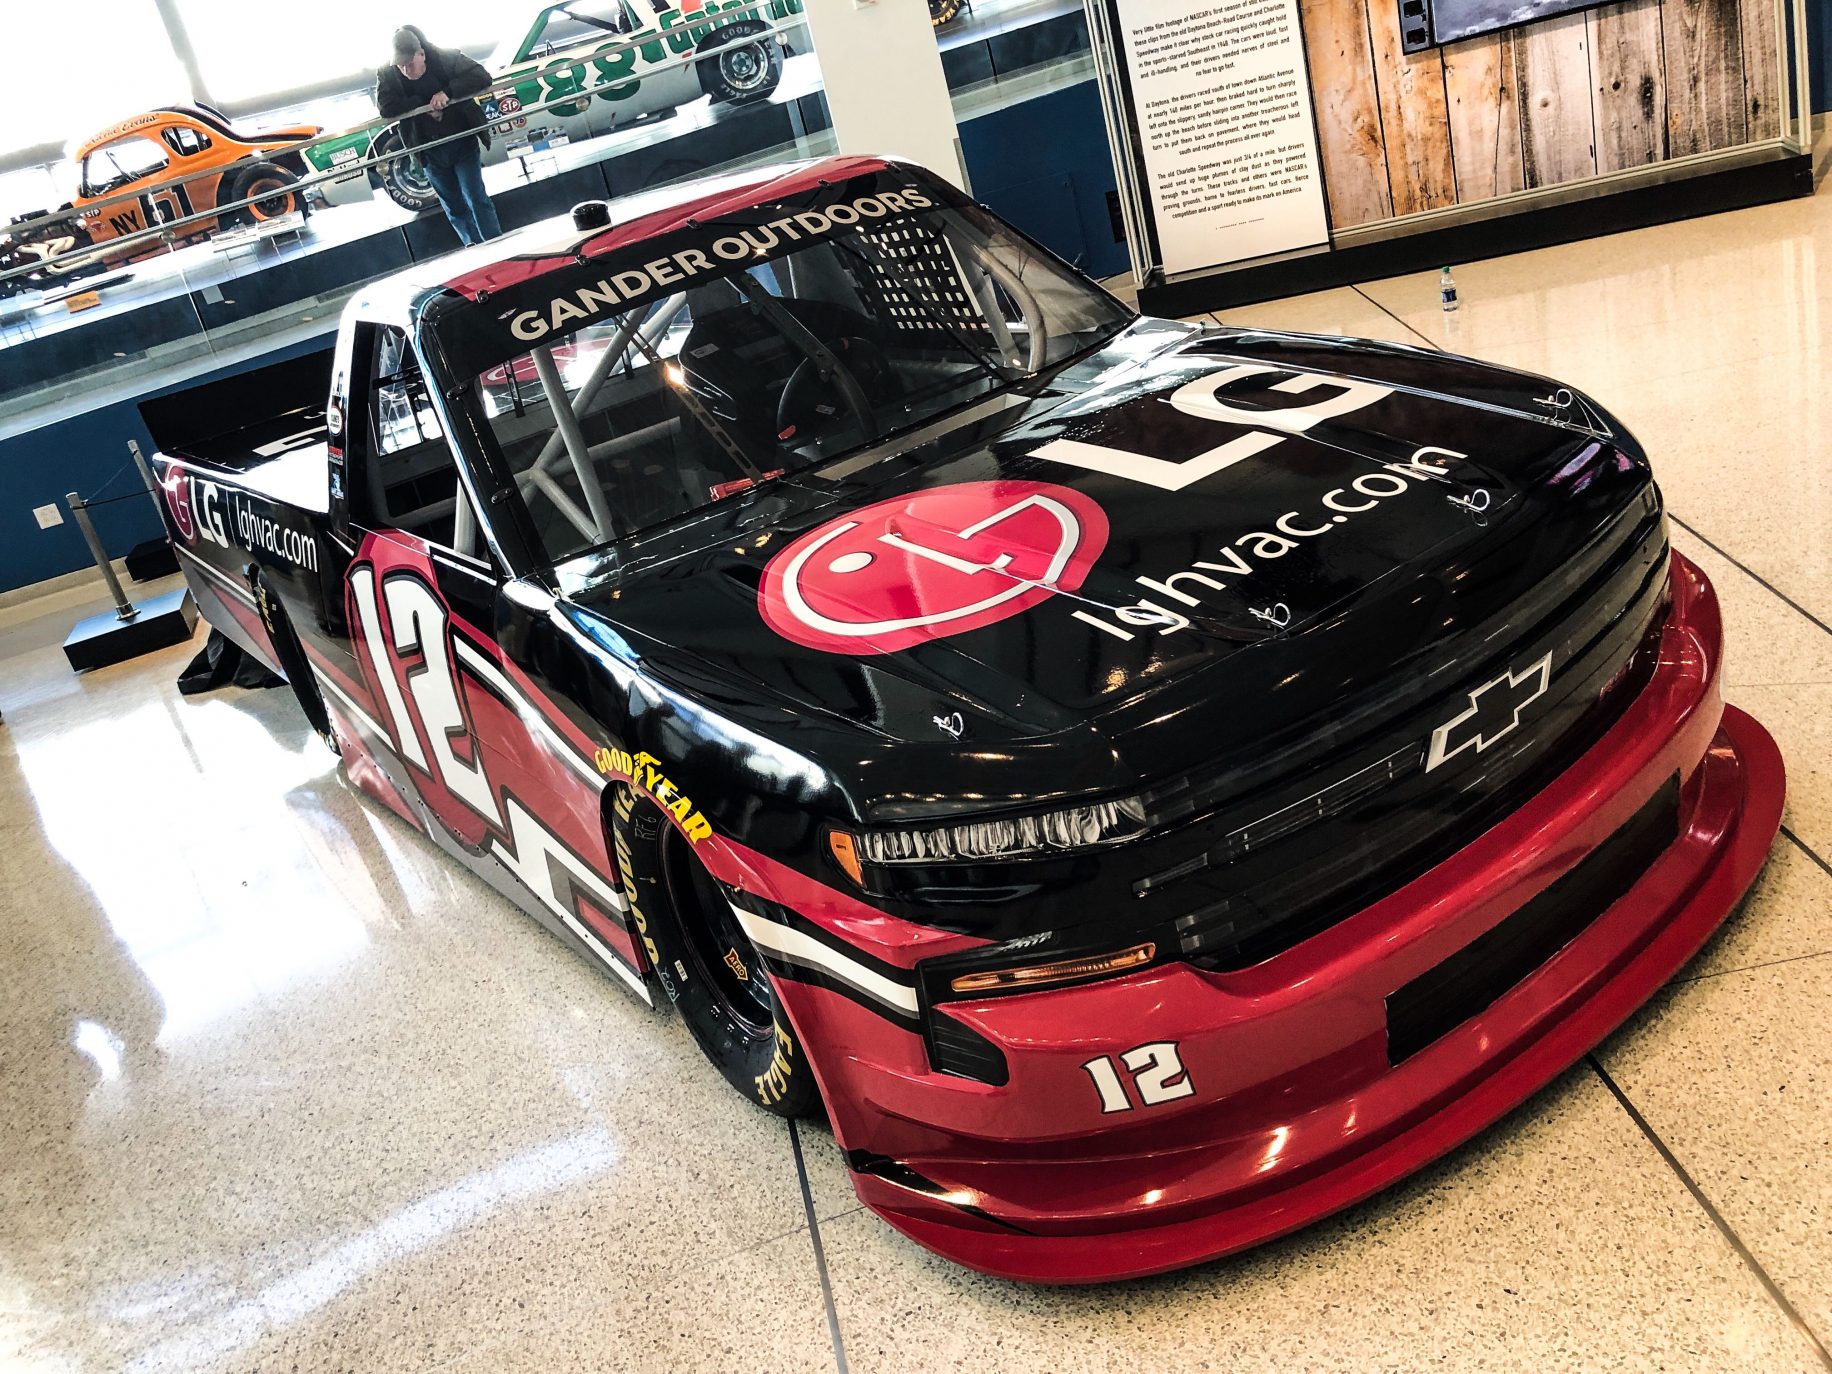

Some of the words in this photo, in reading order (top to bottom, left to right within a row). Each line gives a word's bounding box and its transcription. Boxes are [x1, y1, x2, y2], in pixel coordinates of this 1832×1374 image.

[1136, 47, 1159, 57] Speedway
[1160, 43, 1173, 51] make
[1178, 39, 1189, 47] clear
[1201, 32, 1214, 41] stock
[1224, 26, 1239, 34] racing
[1240, 22, 1257, 32] quickly
[1258, 17, 1275, 26] caught
[1275, 13, 1287, 21] hold
[1179, 27, 1187, 35] old
[1187, 24, 1206, 33] Daytona
[1206, 15, 1235, 28] Beach-Road
[1235, 11, 1253, 20] Course
[1253, 7, 1263, 16] and
[1263, 3, 1285, 13] Charlotte
[1140, 71, 1149, 79] and
[1180, 61, 1189, 69] and
[1203, 54, 1220, 63] drivers
[1222, 49, 1239, 58] needed
[1241, 45, 1258, 53] nerves
[1266, 39, 1278, 47] steel
[1280, 35, 1290, 44] and
[1152, 51, 1186, 65] sports-starved
[1186, 45, 1210, 56] Southeast
[543, 42, 641, 117] 88
[1179, 92, 1196, 100] drivers
[1197, 87, 1211, 96] raced
[1211, 84, 1224, 93] south
[1243, 77, 1257, 85] down
[1258, 73, 1275, 81] Atlantic
[1276, 68, 1294, 77] Avenue
[502, 99, 518, 112] STP
[1148, 122, 1157, 130] left
[1197, 110, 1211, 118] sandy
[1259, 95, 1273, 103] would
[1153, 109, 1168, 117] nearly
[1193, 102, 1201, 110] per
[1228, 90, 1245, 100] braked
[1246, 87, 1258, 95] hard
[1277, 79, 1295, 88] sharply
[1150, 132, 1163, 140] north
[1181, 125, 1195, 133] beach
[1196, 121, 1212, 129] before
[1213, 117, 1229, 125] sliding
[1260, 104, 1288, 114] treacherous
[1194, 133, 1206, 141] back
[1242, 122, 1257, 130] where
[1271, 114, 1286, 123] would
[1287, 111, 1300, 119] head
[1167, 170, 1175, 178] old
[1176, 166, 1196, 175] Charlotte
[1197, 161, 1220, 171] Speedway
[1233, 155, 1242, 164] just
[1277, 145, 1286, 153] but
[1287, 142, 1304, 150] drivers
[1178, 147, 1191, 155] south
[1192, 144, 1201, 152] and
[1201, 141, 1216, 150] repeat
[1224, 136, 1243, 146] process
[1159, 181, 1173, 189] would
[1175, 178, 1187, 186] send
[1211, 170, 1228, 179] plumes
[1285, 152, 1306, 163] powered
[1160, 191, 1178, 200] through
[1223, 178, 1238, 186] tracks
[1240, 175, 1250, 183] and
[1252, 172, 1267, 180] others
[1163, 202, 1180, 211] proving
[1227, 188, 1245, 196] fearless
[1172, 209, 1197, 218] competition
[1198, 205, 1207, 213] and
[1211, 202, 1223, 211] sport
[1262, 191, 1274, 199] mark
[109, 210, 141, 236] NY
[510, 249, 715, 341] GANDER
[712, 188, 932, 261] OUTDOORS
[1025, 364, 1396, 492] LG
[190, 476, 229, 549] LG
[236, 496, 318, 573] lghvac.com
[1071, 446, 1469, 643] lghvac.com
[350, 568, 506, 831] 12
[594, 747, 713, 845] GOODYEAR
[728, 955, 746, 976] AERO
[754, 1016, 793, 1105] EAGLE
[1081, 1041, 1196, 1114] 12
